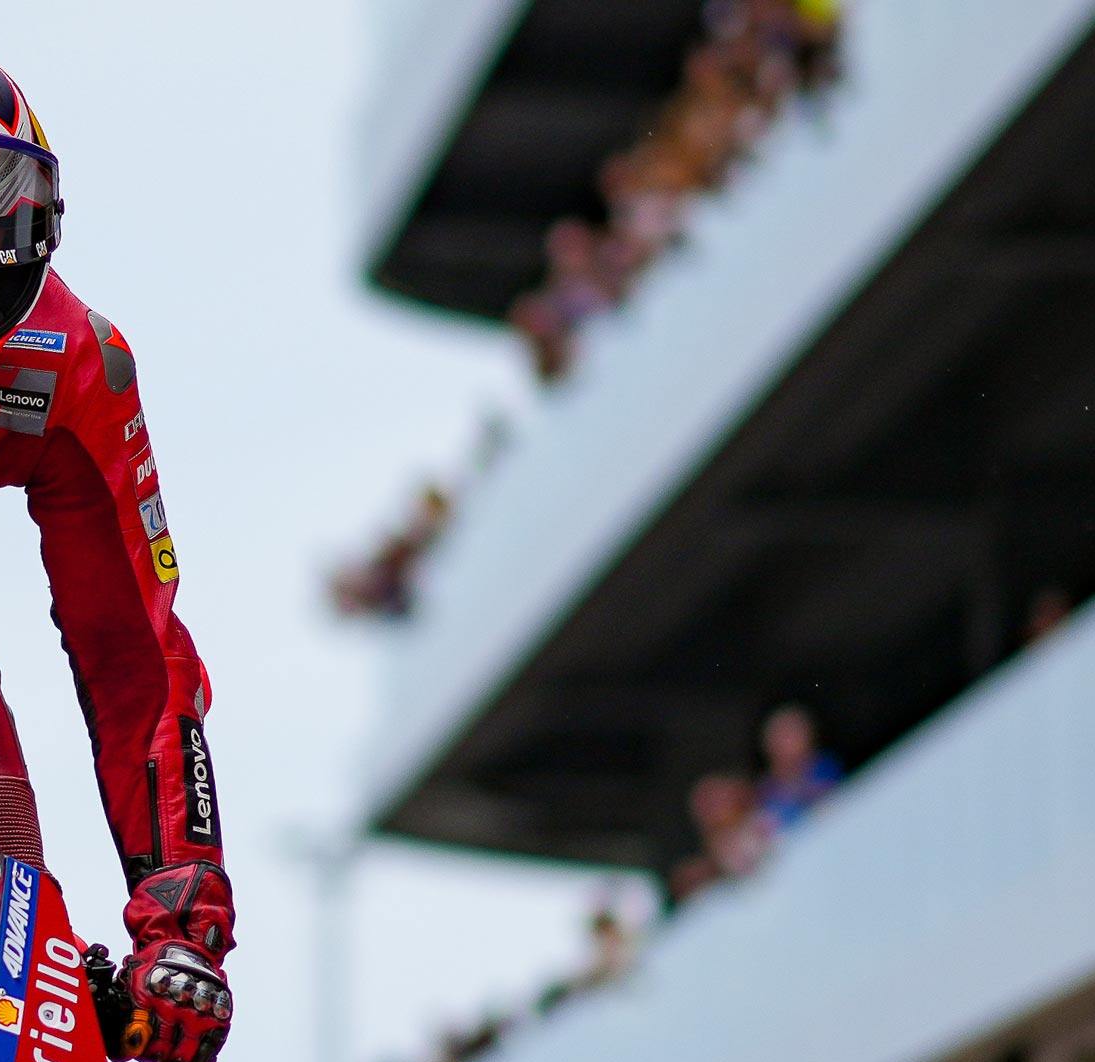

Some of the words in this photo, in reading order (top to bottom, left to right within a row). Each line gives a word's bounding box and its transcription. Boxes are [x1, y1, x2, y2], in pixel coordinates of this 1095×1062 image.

[35, 240, 48, 256] CAT
[8, 334, 57, 345] ICHELIN
[0, 389, 45, 408] Lenovo
[192, 728, 212, 836] Lenovo
[2, 861, 33, 980] ADVANCE
